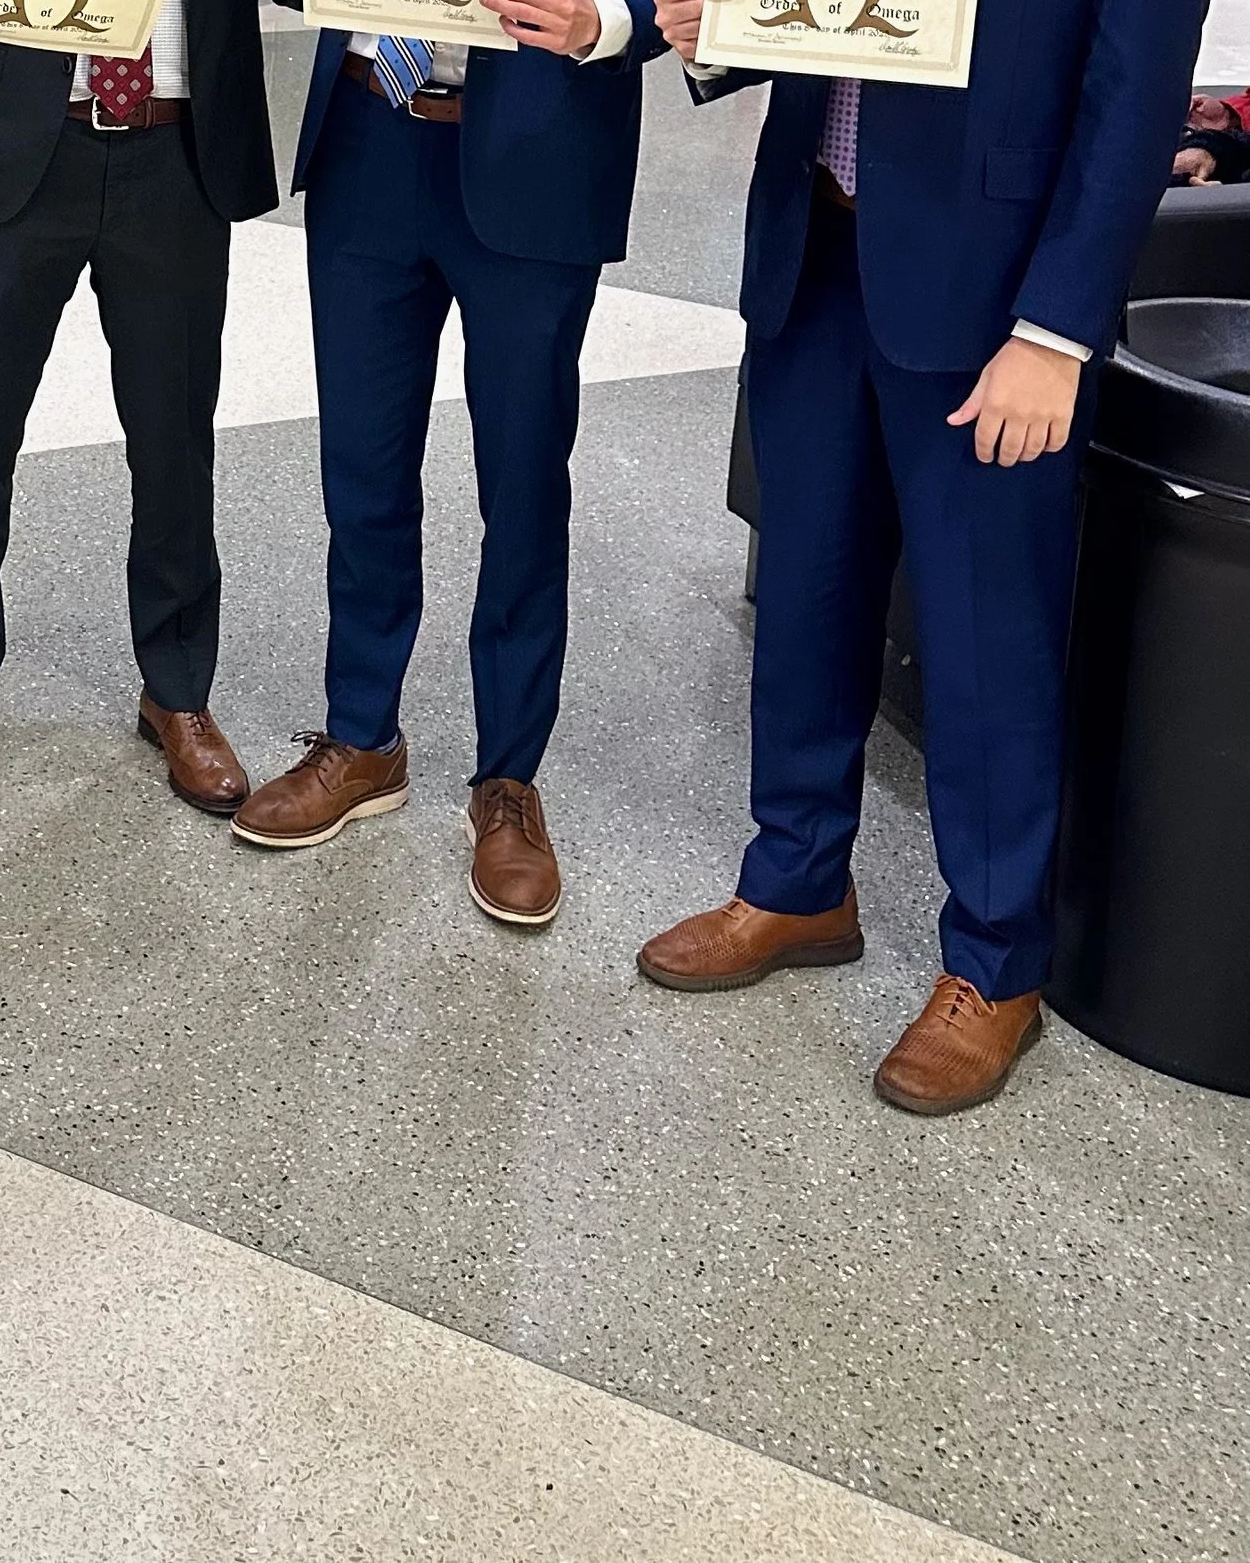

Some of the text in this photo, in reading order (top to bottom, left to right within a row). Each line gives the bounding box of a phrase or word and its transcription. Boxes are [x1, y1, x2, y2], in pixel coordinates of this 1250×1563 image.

[40, 8, 53, 17] of
[71, 10, 115, 24] Omega
[828, 1, 843, 15] of
[866, 3, 920, 22] Omega
